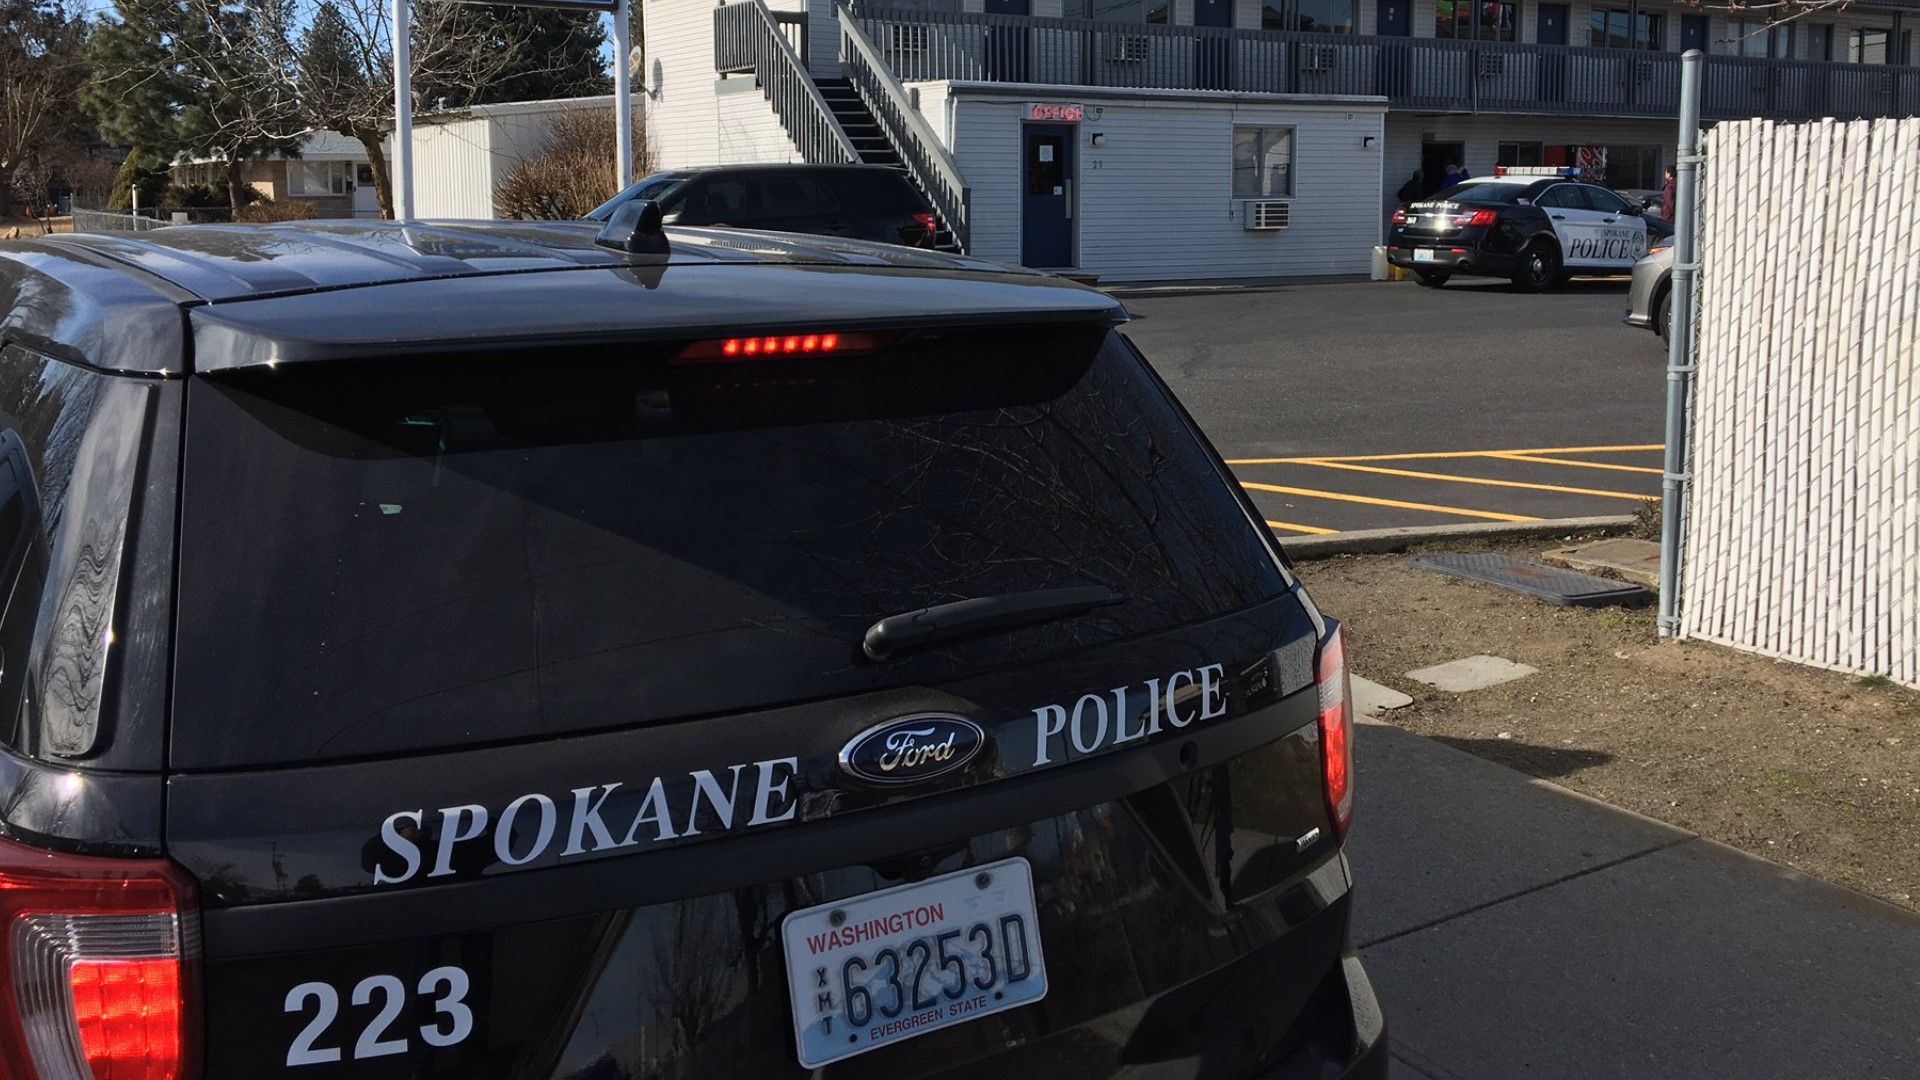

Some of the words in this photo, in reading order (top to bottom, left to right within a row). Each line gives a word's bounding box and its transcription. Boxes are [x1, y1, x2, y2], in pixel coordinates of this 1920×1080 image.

[1032, 104, 1082, 120] OFFICE
[1436, 200, 1460, 209] POLICE
[1569, 238, 1630, 259] POLICE
[1603, 228, 1630, 238] SPOKANE
[1031, 662, 1228, 768] POLICE
[879, 727, 956, 772] Ford
[372, 755, 800, 886] SPOKANE
[806, 902, 945, 955] WASHINGTON
[842, 913, 1032, 1028] 63253D
[283, 965, 474, 1067] 223
[870, 1009, 943, 1040] EVERGREEN
[949, 995, 988, 1016] STATE
